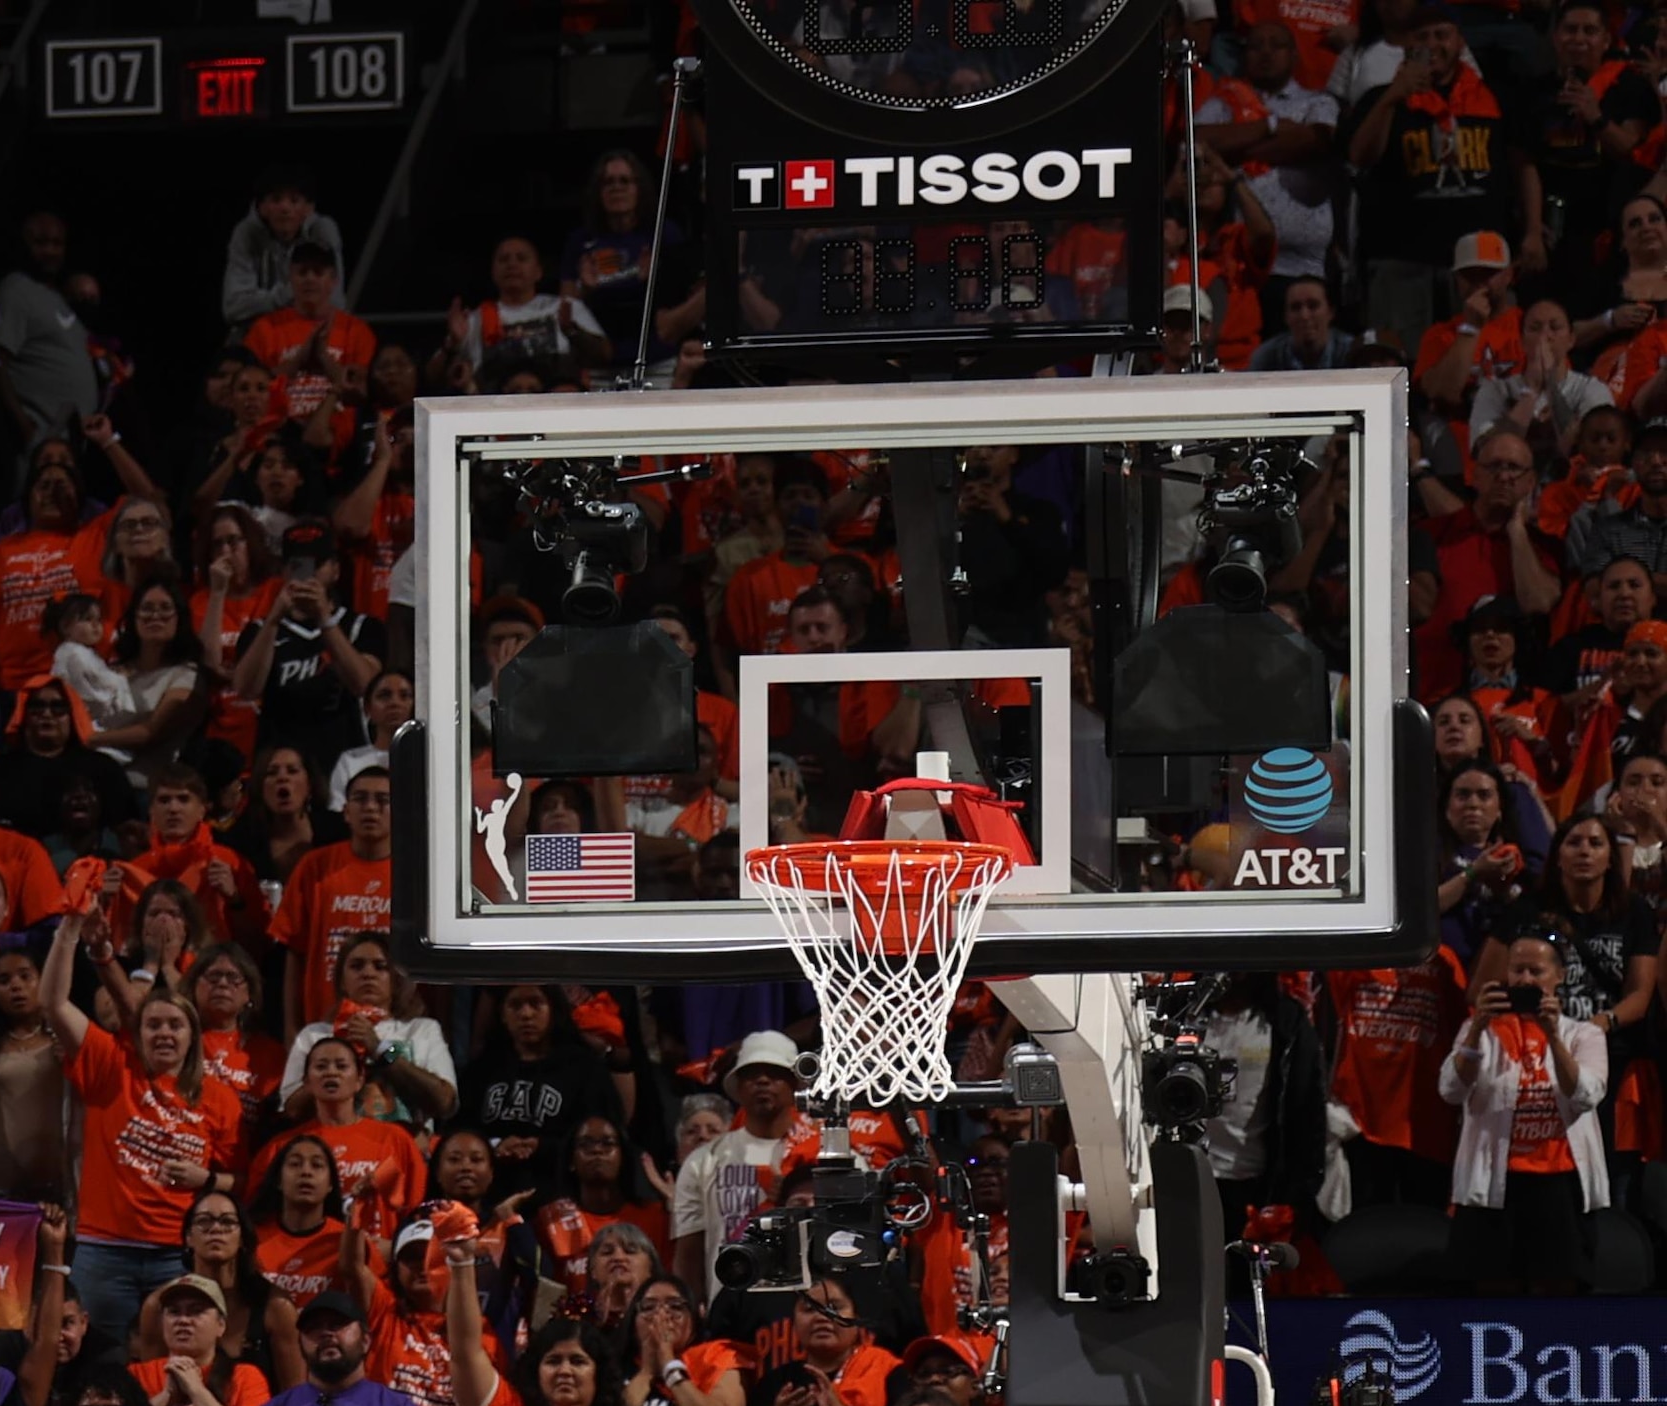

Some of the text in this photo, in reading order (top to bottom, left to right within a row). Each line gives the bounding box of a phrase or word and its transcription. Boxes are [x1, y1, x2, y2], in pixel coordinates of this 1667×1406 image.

[68, 51, 145, 104] 107
[197, 70, 258, 116] EXIT
[308, 45, 388, 100] 108
[1401, 126, 1493, 177] CLRK
[844, 148, 1133, 208] TISSOT
[1233, 846, 1348, 888] AT&T
[331, 894, 393, 914] MERCU
[482, 1081, 566, 1128] GAP
[1461, 1322, 1667, 1404] Ban
